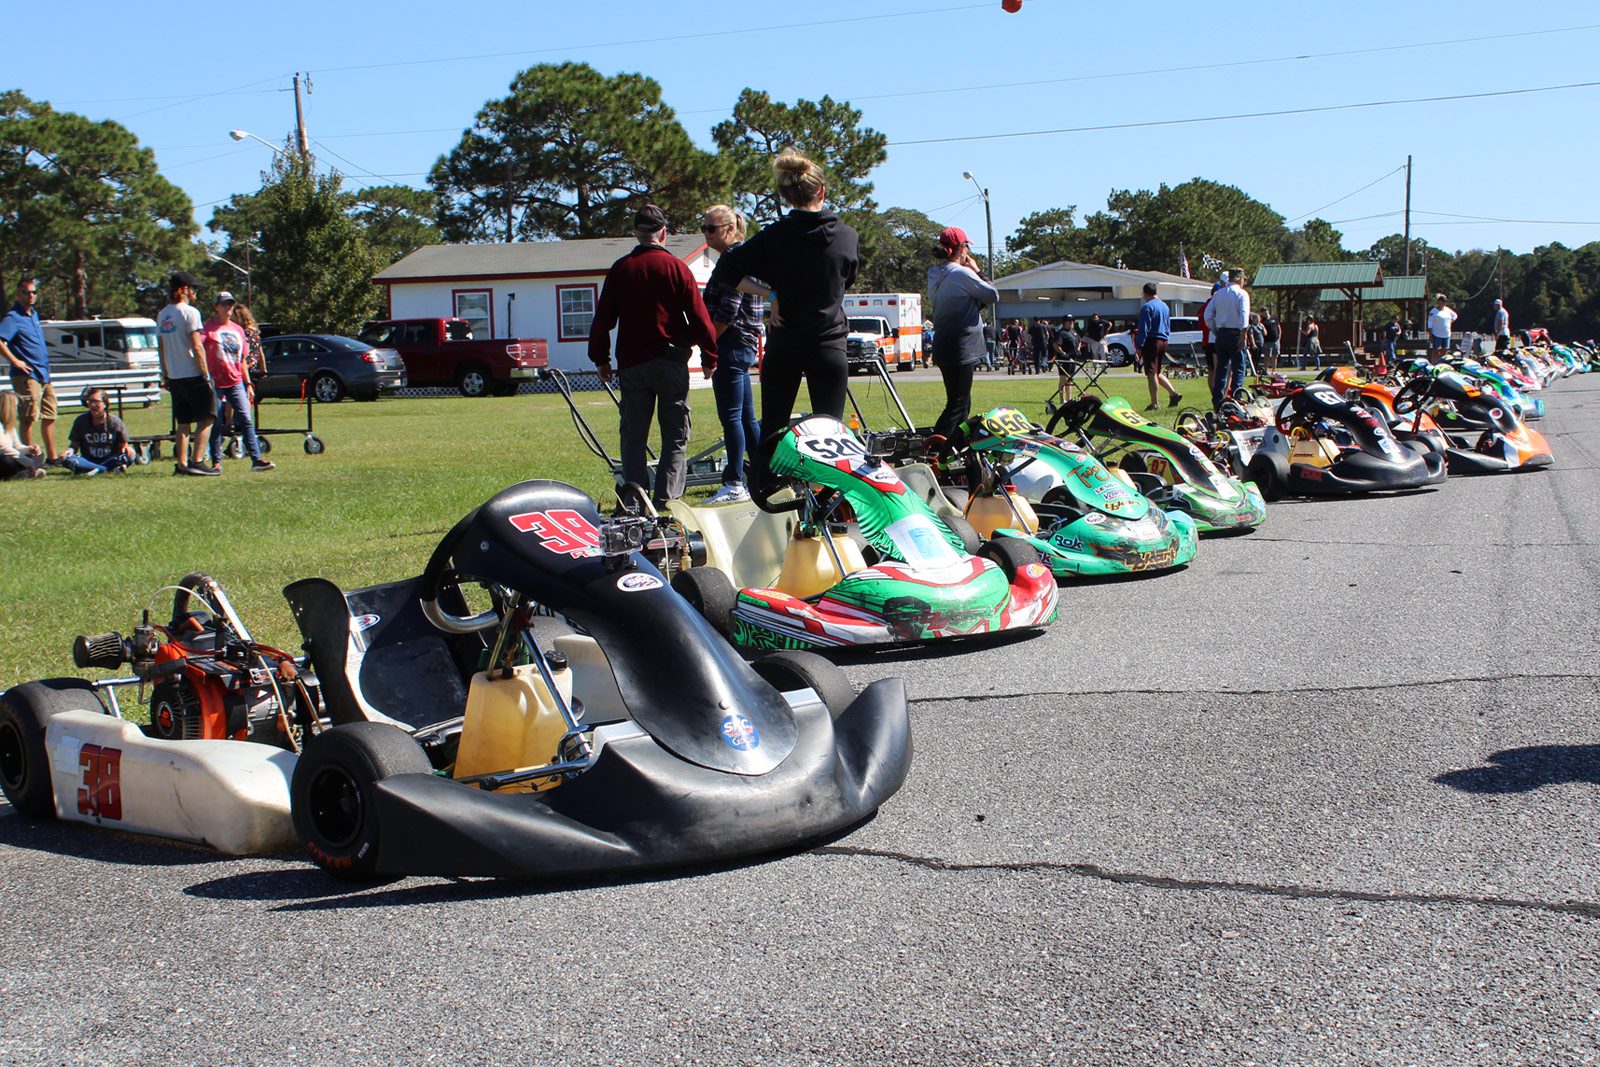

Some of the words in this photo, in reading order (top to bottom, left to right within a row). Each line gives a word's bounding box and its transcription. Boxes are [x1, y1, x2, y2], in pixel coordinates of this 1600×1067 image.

[987, 413, 1030, 438] 956
[804, 437, 867, 459] 520
[508, 509, 601, 554] 38
[77, 743, 122, 820] 38
